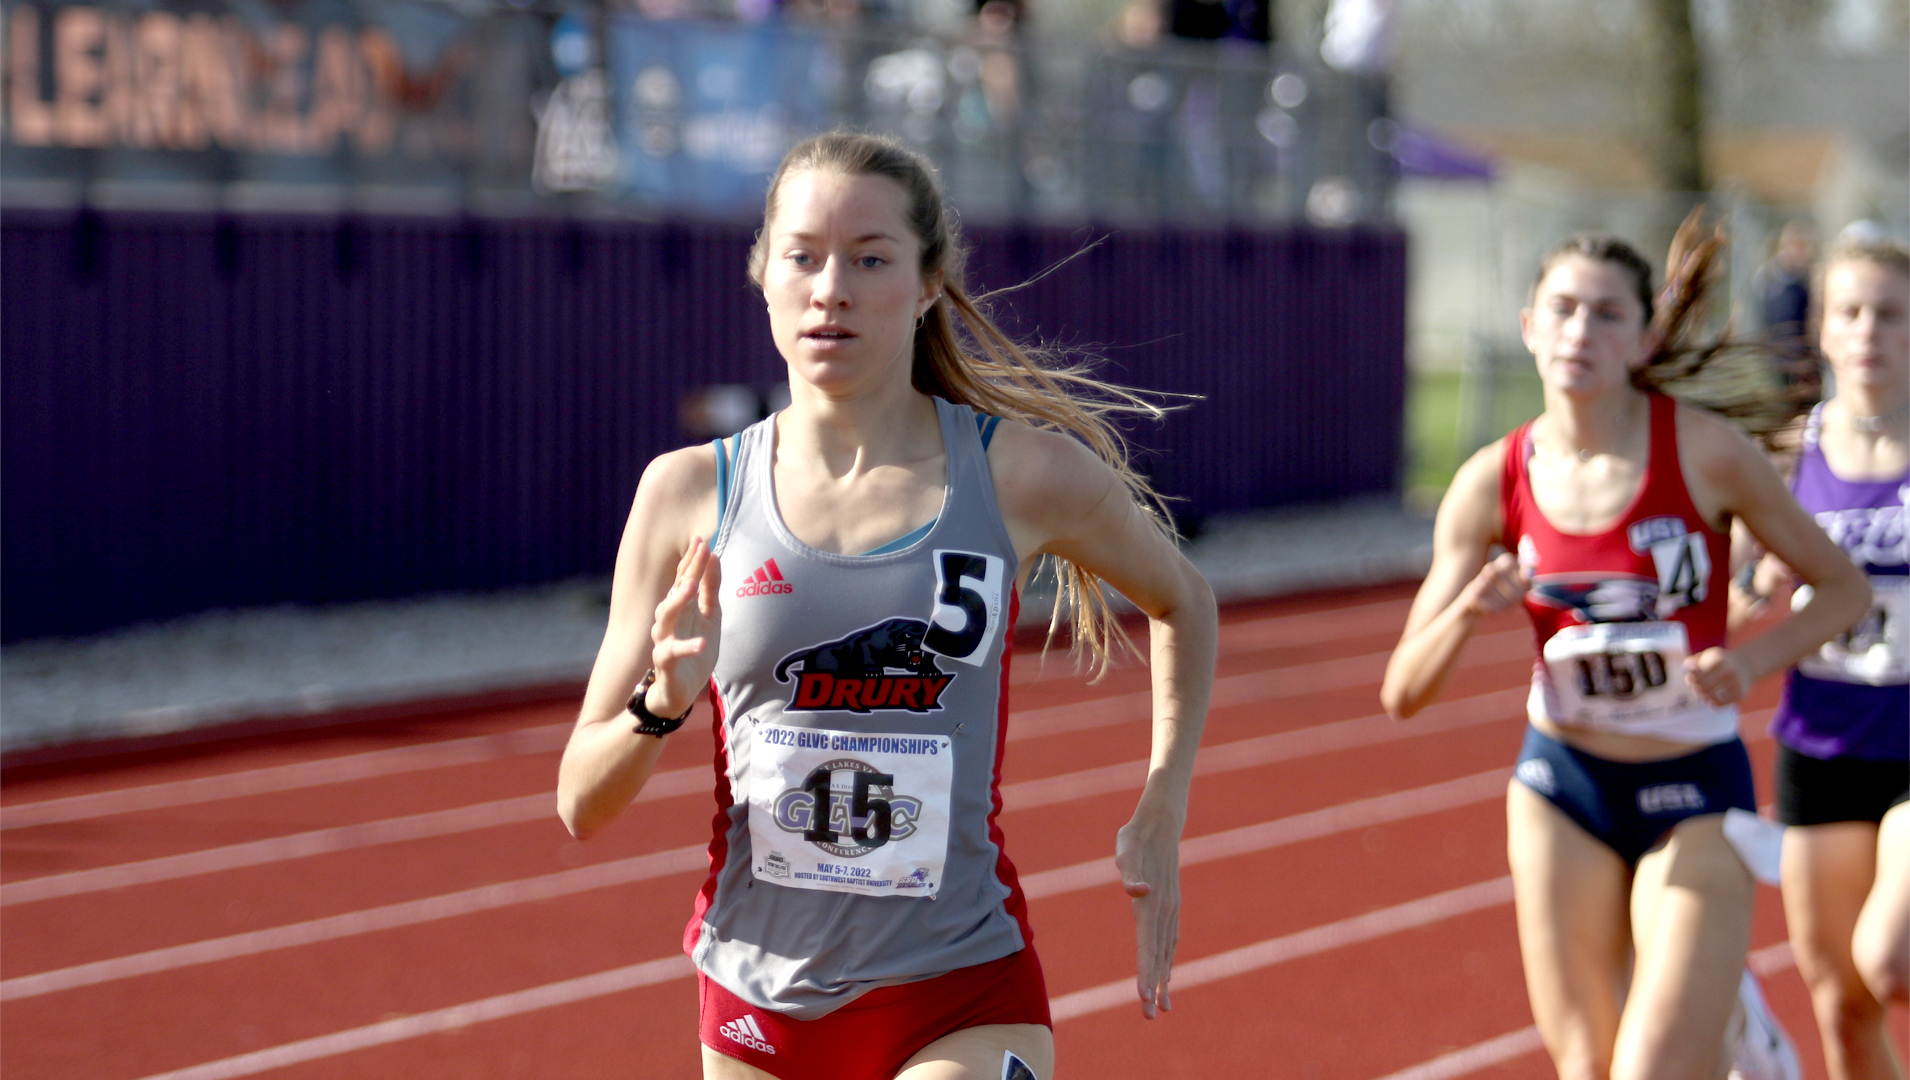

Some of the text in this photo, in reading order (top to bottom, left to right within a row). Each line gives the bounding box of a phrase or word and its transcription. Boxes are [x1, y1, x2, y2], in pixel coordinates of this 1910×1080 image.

[1662, 537, 1700, 603] 4
[736, 581, 793, 598] adidas
[923, 552, 988, 658] 5
[1576, 650, 1668, 697] 150
[795, 673, 948, 709] DRURY
[764, 728, 938, 755] 2022 GLVC CHAMPIONSHIPS
[832, 761, 860, 769] LAKES
[804, 769, 894, 848] 15
[794, 872, 813, 880] HOSTED
[819, 875, 846, 884] SOUTHWEST
[846, 877, 866, 886] BAPTIST
[866, 879, 893, 888] UNIVERSITY
[817, 863, 871, 878] MAY 5-7, 2022
[719, 1023, 776, 1055] adidas
